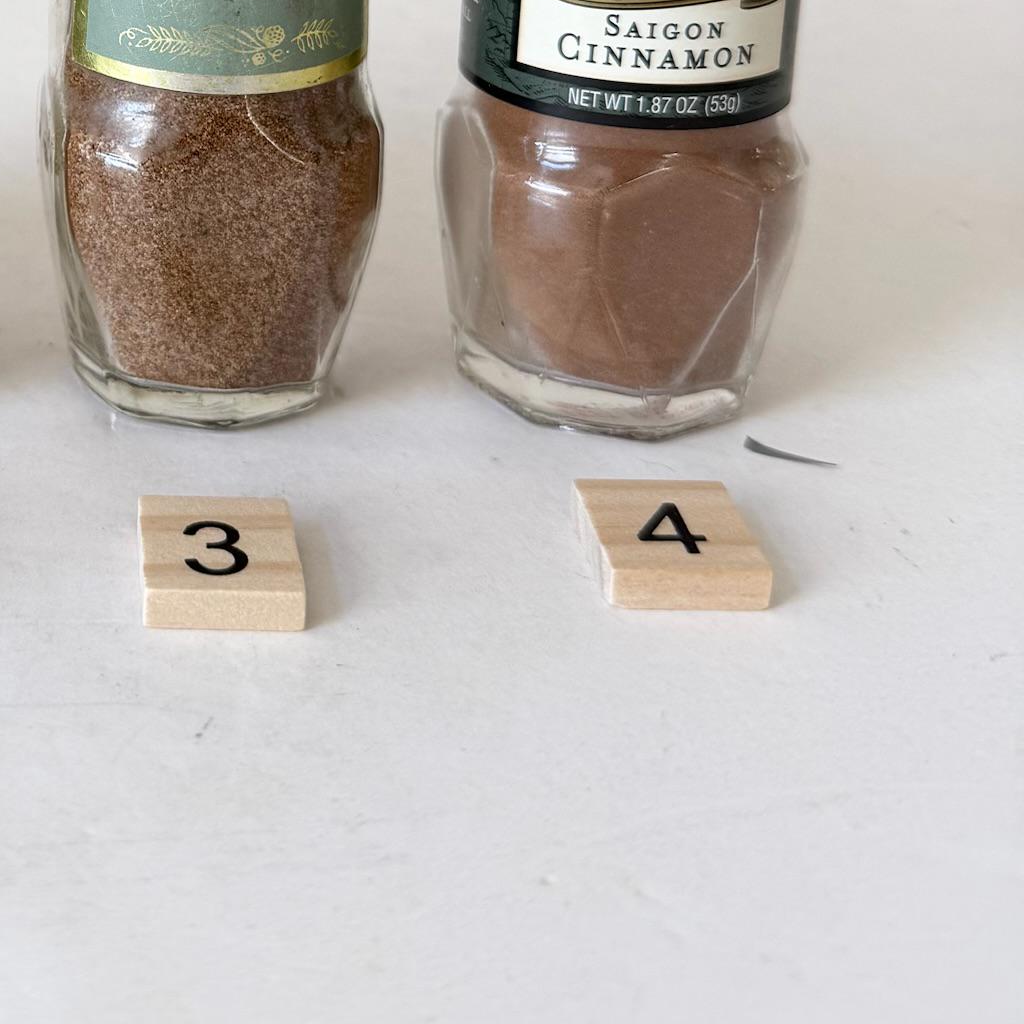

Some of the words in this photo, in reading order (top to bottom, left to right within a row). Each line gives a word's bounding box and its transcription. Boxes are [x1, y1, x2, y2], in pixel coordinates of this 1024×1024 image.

[568, 87, 601, 108] NET
[605, 92, 631, 111] WT
[637, 96, 671, 113] 1.87
[676, 96, 697, 114] OZ
[704, 93, 741, 116] (53g)
[184, 521, 249, 576] 3
[637, 502, 708, 554] 4
